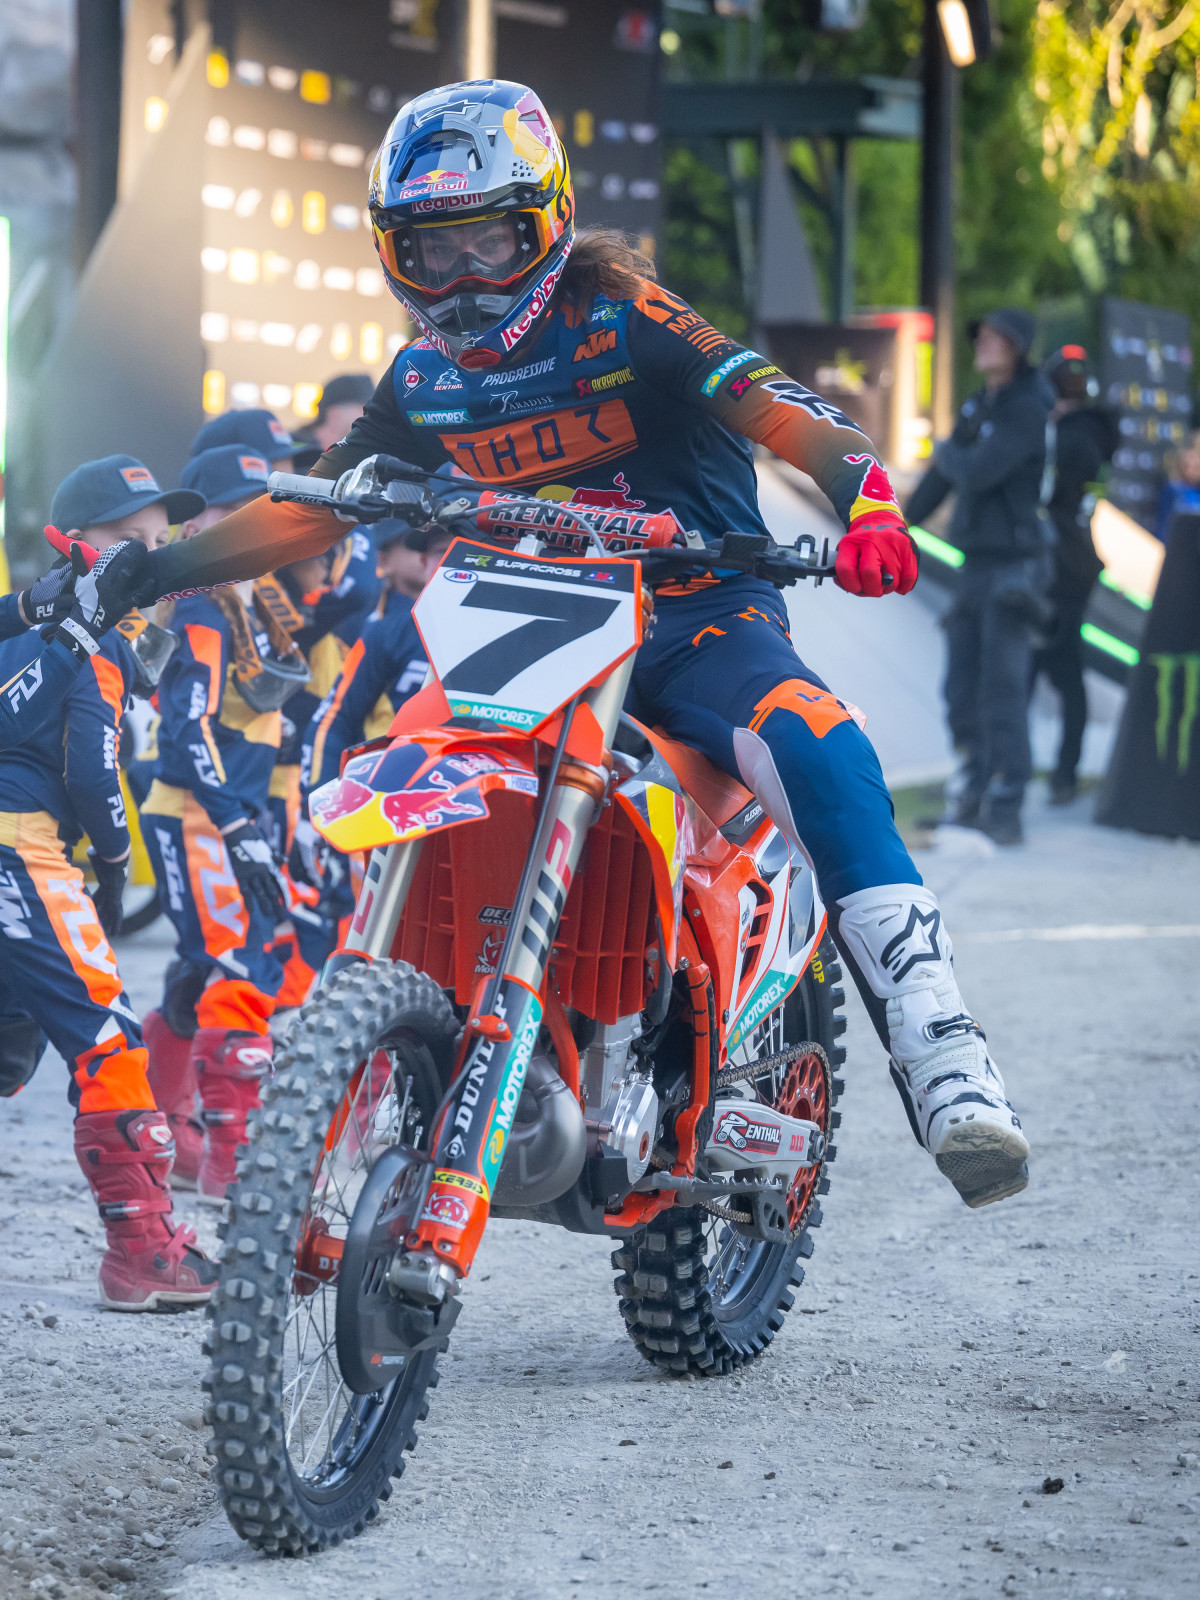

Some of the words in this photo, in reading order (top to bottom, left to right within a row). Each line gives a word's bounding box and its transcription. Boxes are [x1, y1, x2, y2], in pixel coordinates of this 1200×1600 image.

[400, 184, 432, 199] Red
[434, 181, 468, 192] Bull
[573, 329, 616, 362] KTM
[481, 357, 556, 387] PROGRESSIVE
[718, 351, 765, 375] MOTO
[434, 383, 464, 391] RENTHAL
[422, 411, 468, 424] MOTOREX
[488, 506, 651, 538] RENTHAL
[495, 559, 582, 577] SUPERCROSS
[586, 570, 615, 583] AMA
[441, 581, 622, 696] 7
[7, 657, 44, 714] FLY
[471, 704, 535, 726] MOTOREX
[107, 794, 127, 828] FLY
[740, 980, 786, 1036] MOTOREX
[456, 992, 507, 1134] DUNLP
[496, 1013, 541, 1130] MOTOREX
